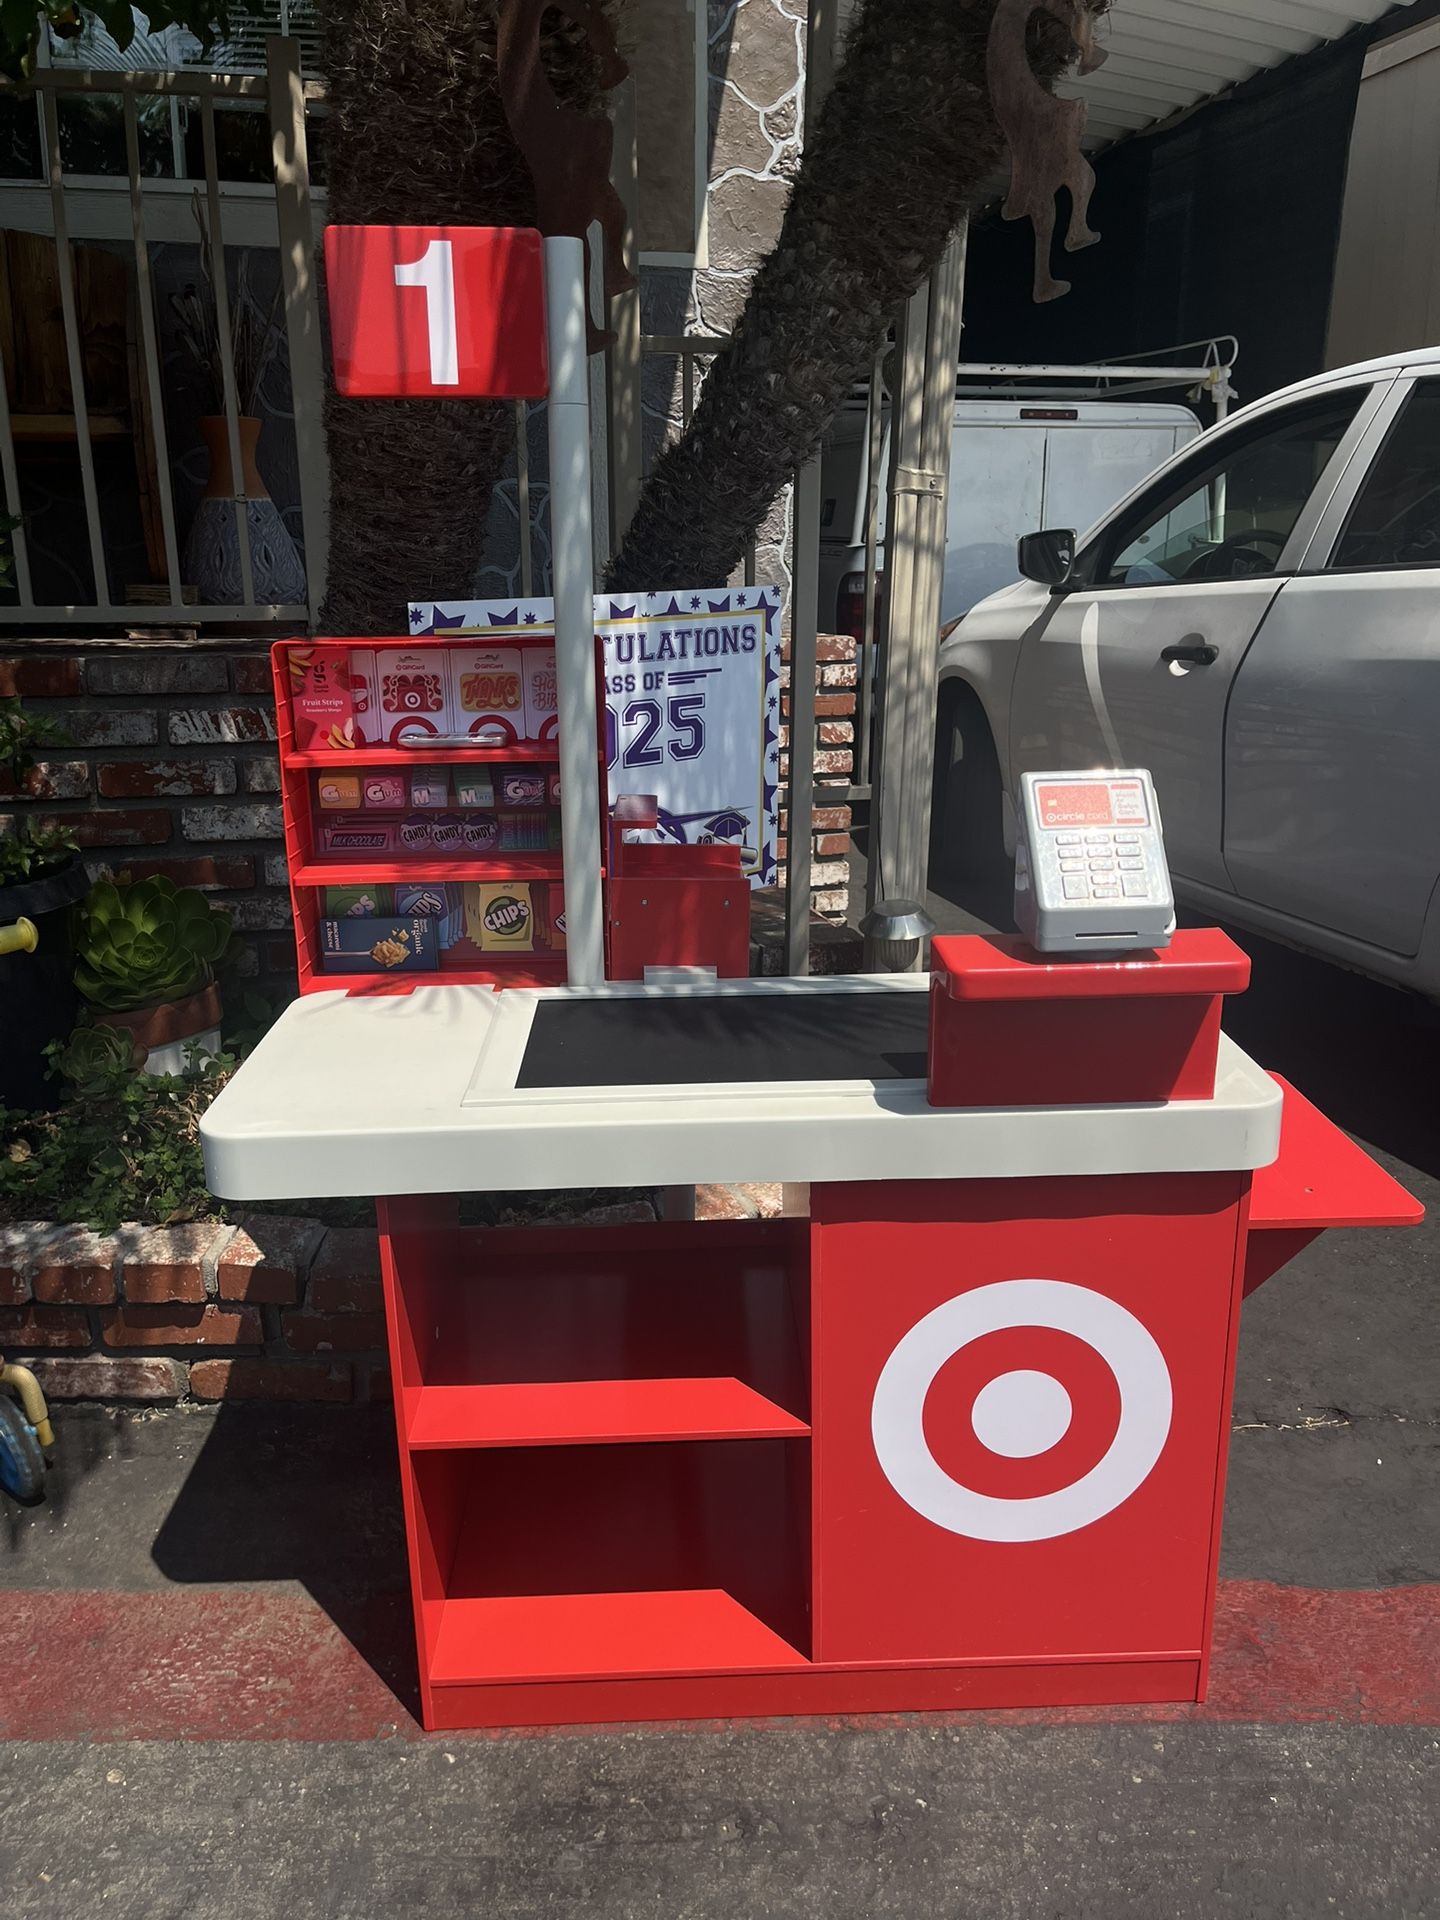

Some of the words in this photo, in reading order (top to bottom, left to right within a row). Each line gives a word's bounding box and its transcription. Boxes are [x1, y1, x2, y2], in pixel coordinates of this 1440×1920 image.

[394, 240, 459, 385] 1
[643, 671, 665, 690] OF
[321, 698, 344, 707] Strips
[366, 784, 401, 802] Gum
[1056, 812, 1086, 821] circle
[1087, 812, 1109, 821] card
[347, 834, 385, 847] CHOCOLATE
[403, 824, 430, 842] CANDY
[434, 824, 460, 842] CANDY
[465, 824, 492, 842] CANDY
[484, 900, 530, 932] CHIPS
[326, 928, 334, 949] cheese
[333, 921, 342, 951] macaroni
[410, 919, 424, 955] organic
